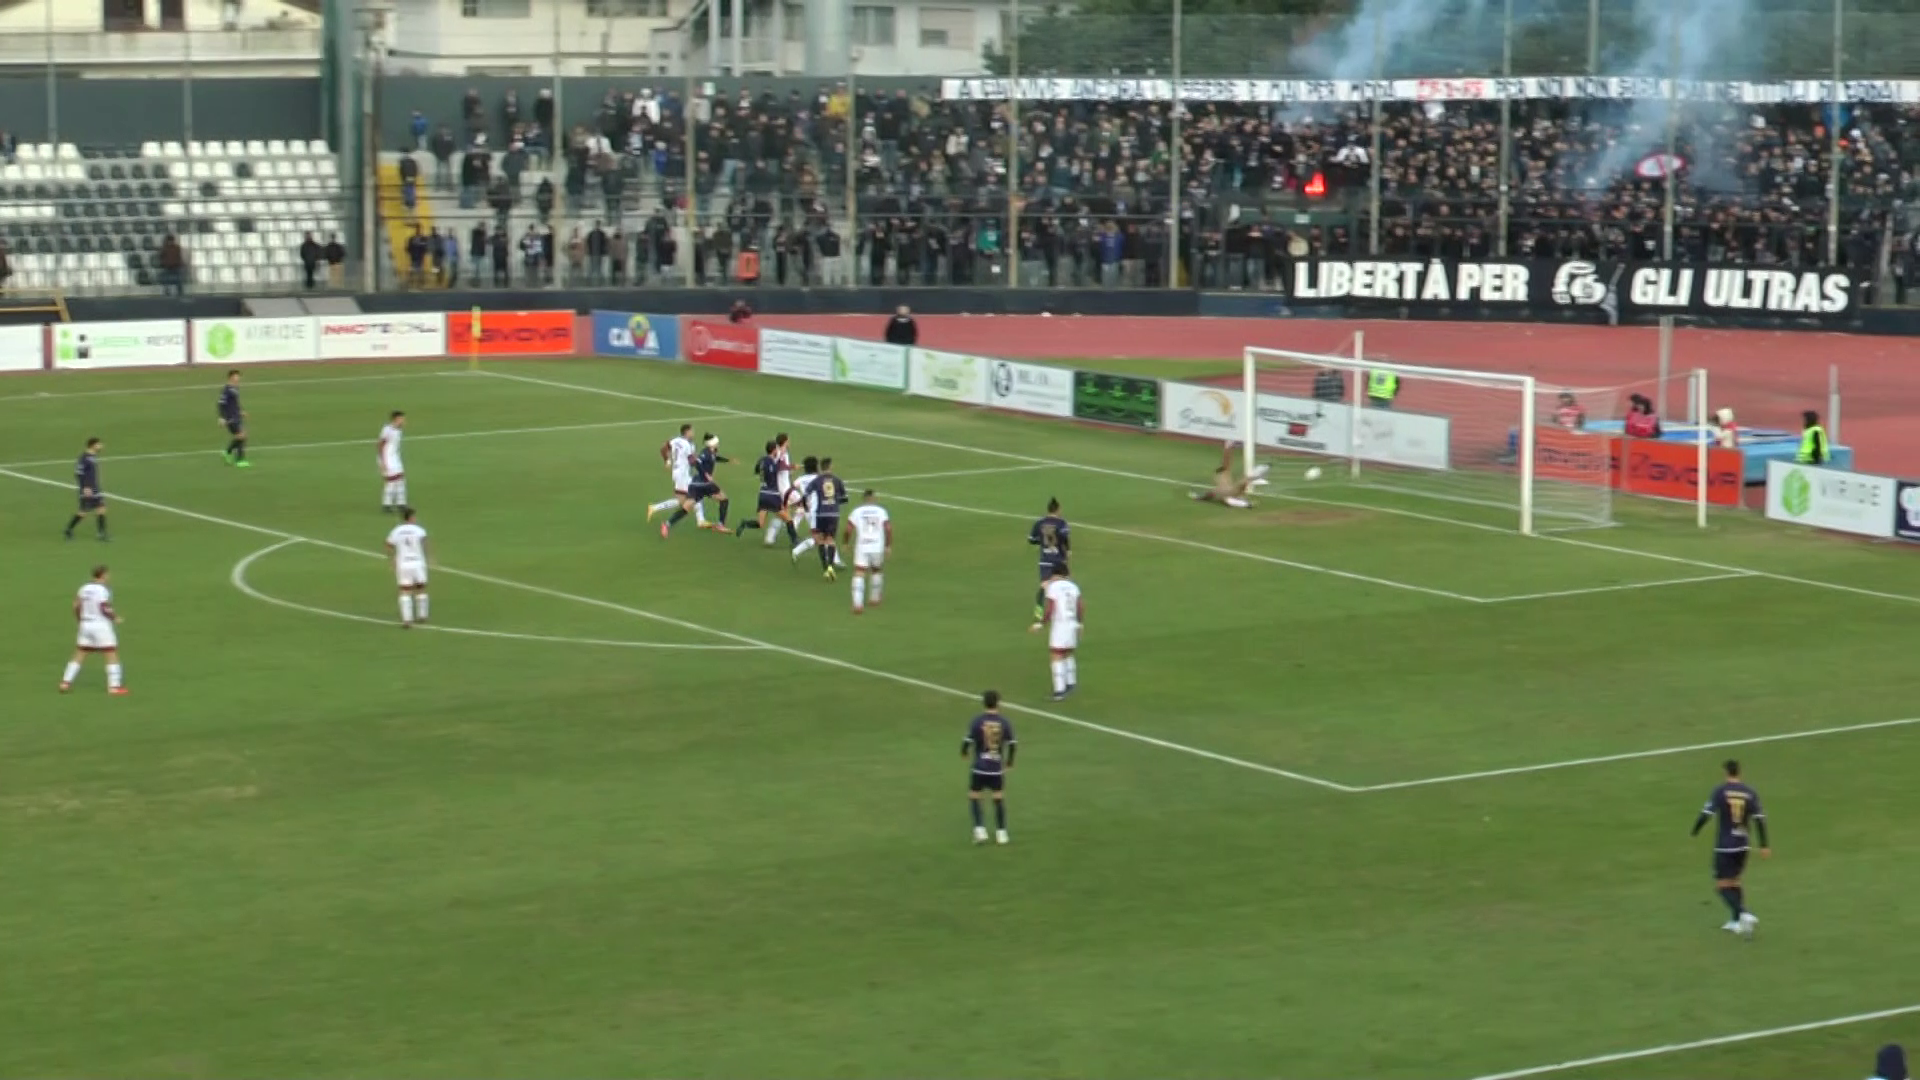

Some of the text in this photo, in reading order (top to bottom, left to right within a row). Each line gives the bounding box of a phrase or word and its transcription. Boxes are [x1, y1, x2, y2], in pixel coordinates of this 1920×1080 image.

[1294, 258, 1850, 313] LIBERTÀ PER GLI ULTRAS
